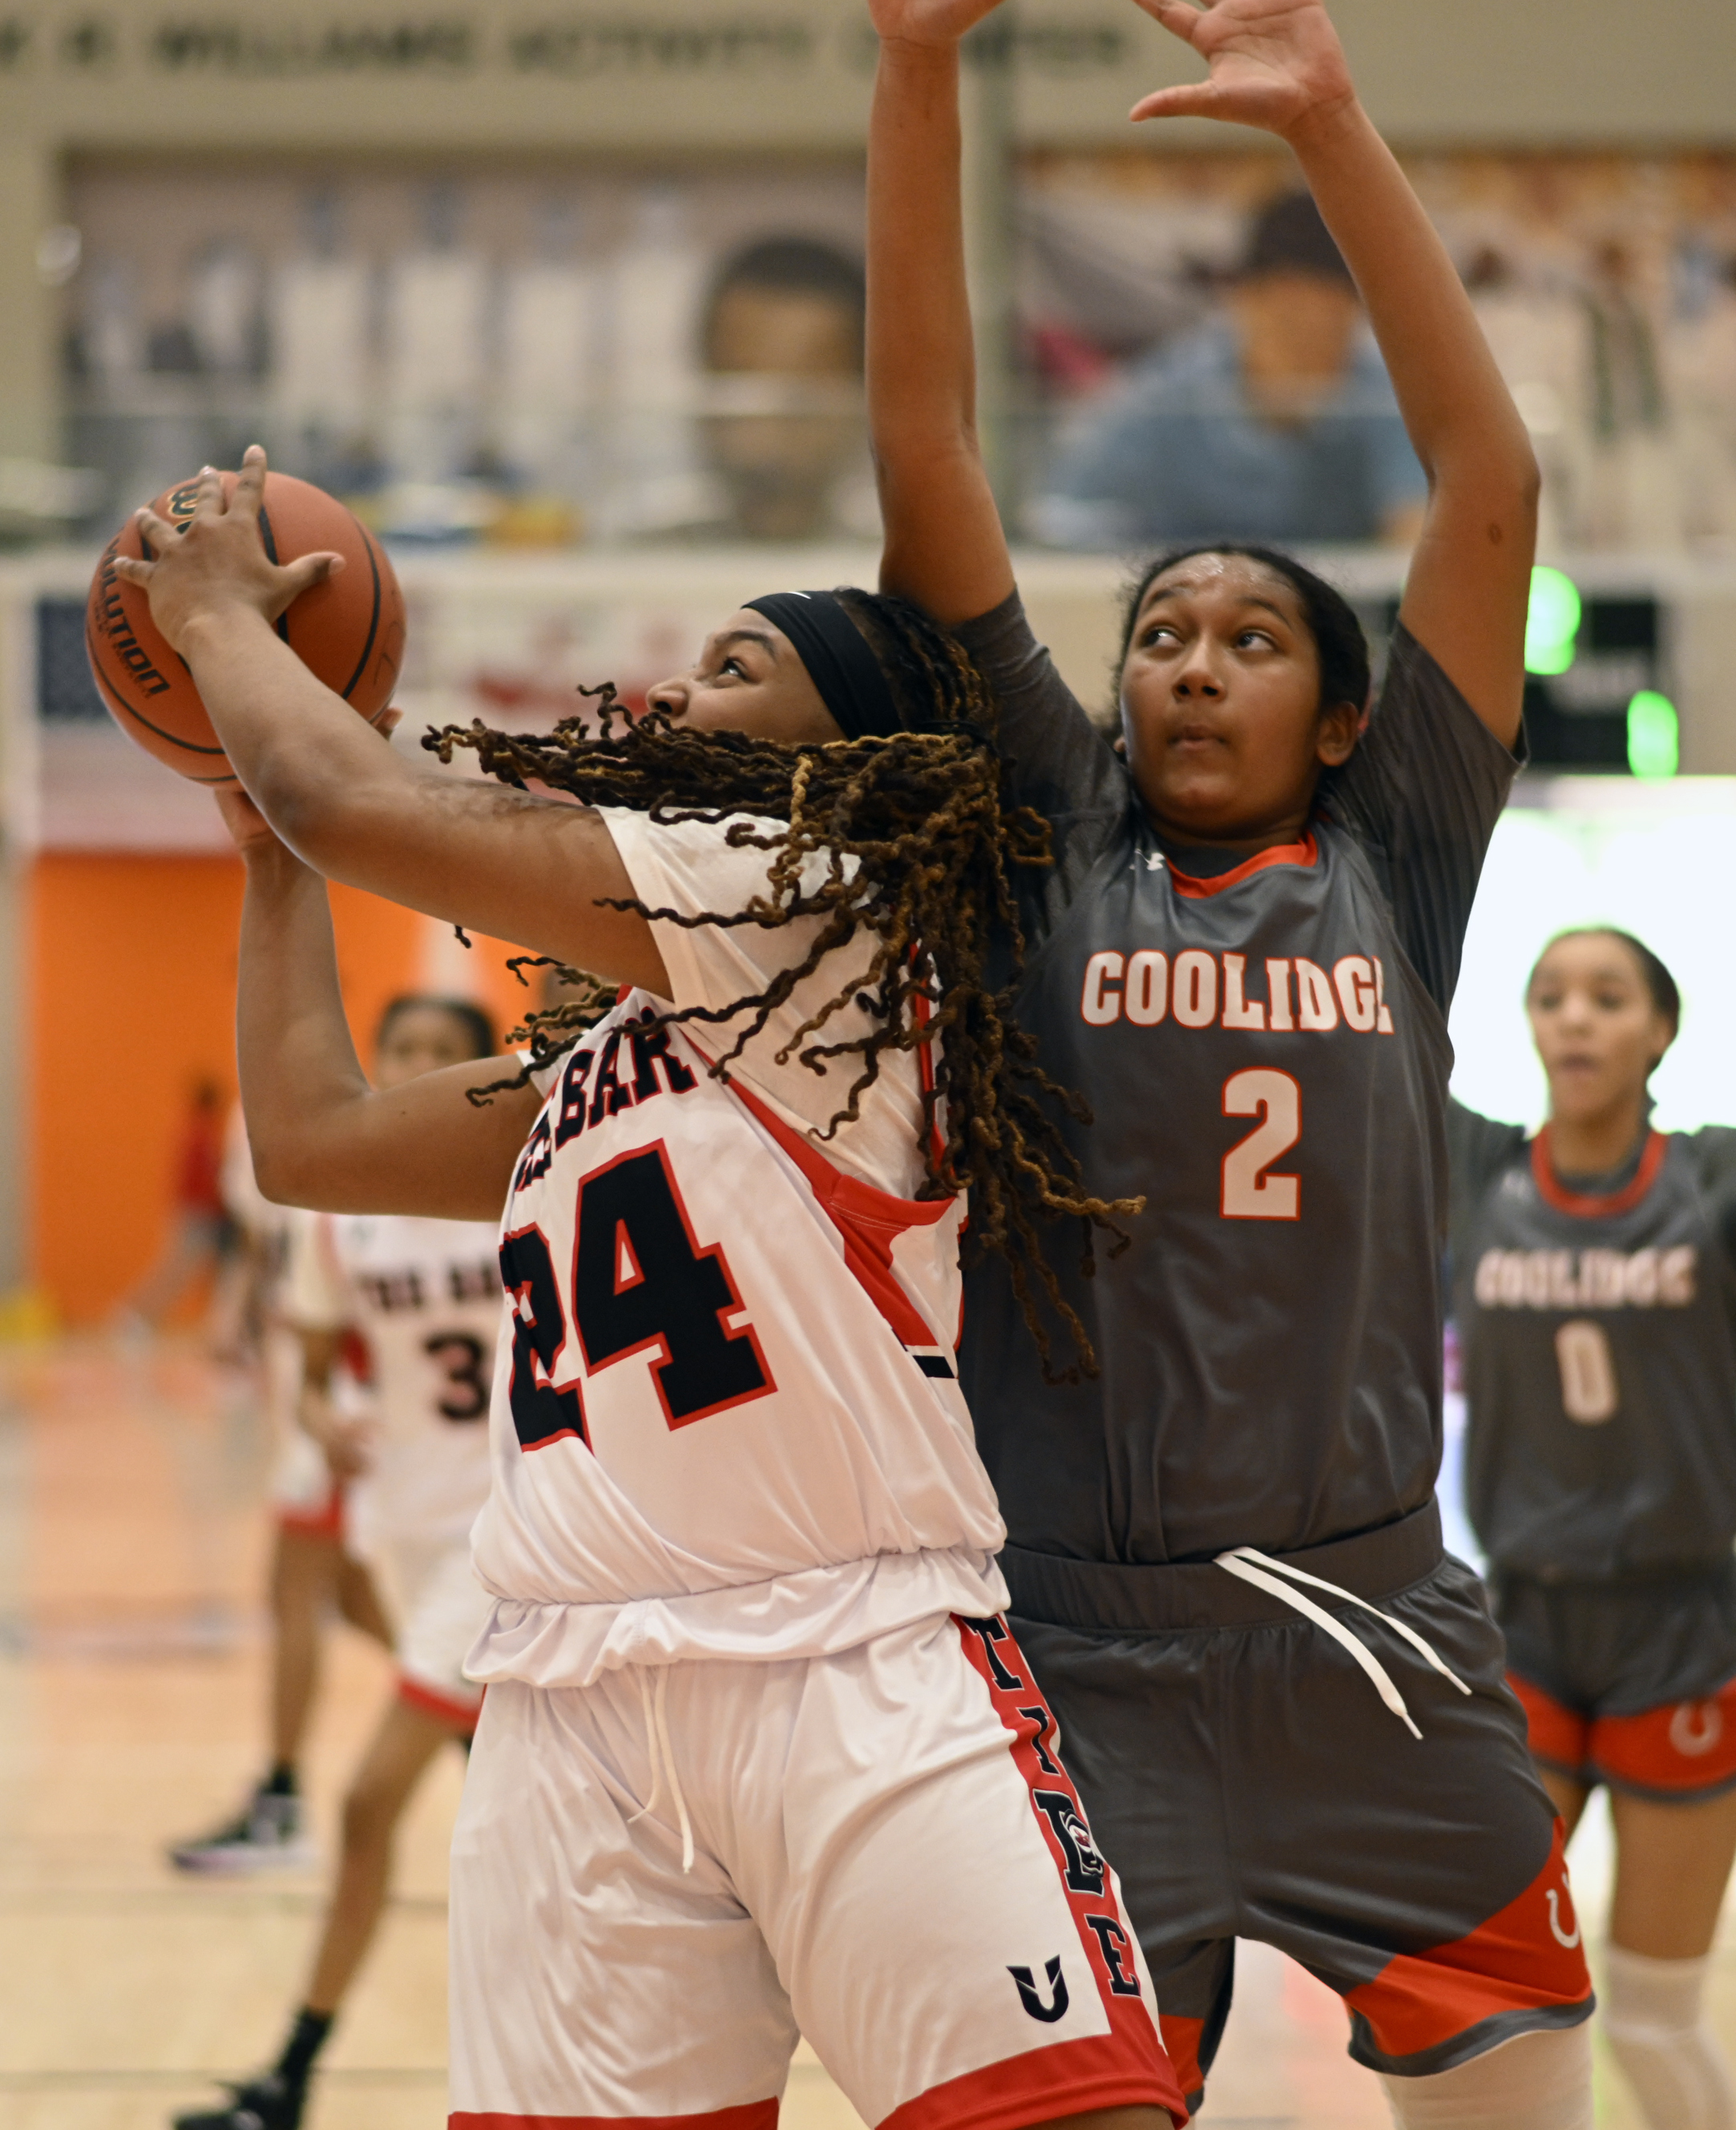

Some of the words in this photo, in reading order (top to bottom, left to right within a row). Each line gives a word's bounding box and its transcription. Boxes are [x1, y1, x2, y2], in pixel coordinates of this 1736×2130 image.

[1220, 1065, 1302, 1221] 2
[499, 1137, 778, 1458] 24
[425, 1332, 491, 1423] 3
[1552, 1321, 1619, 1428] 0
